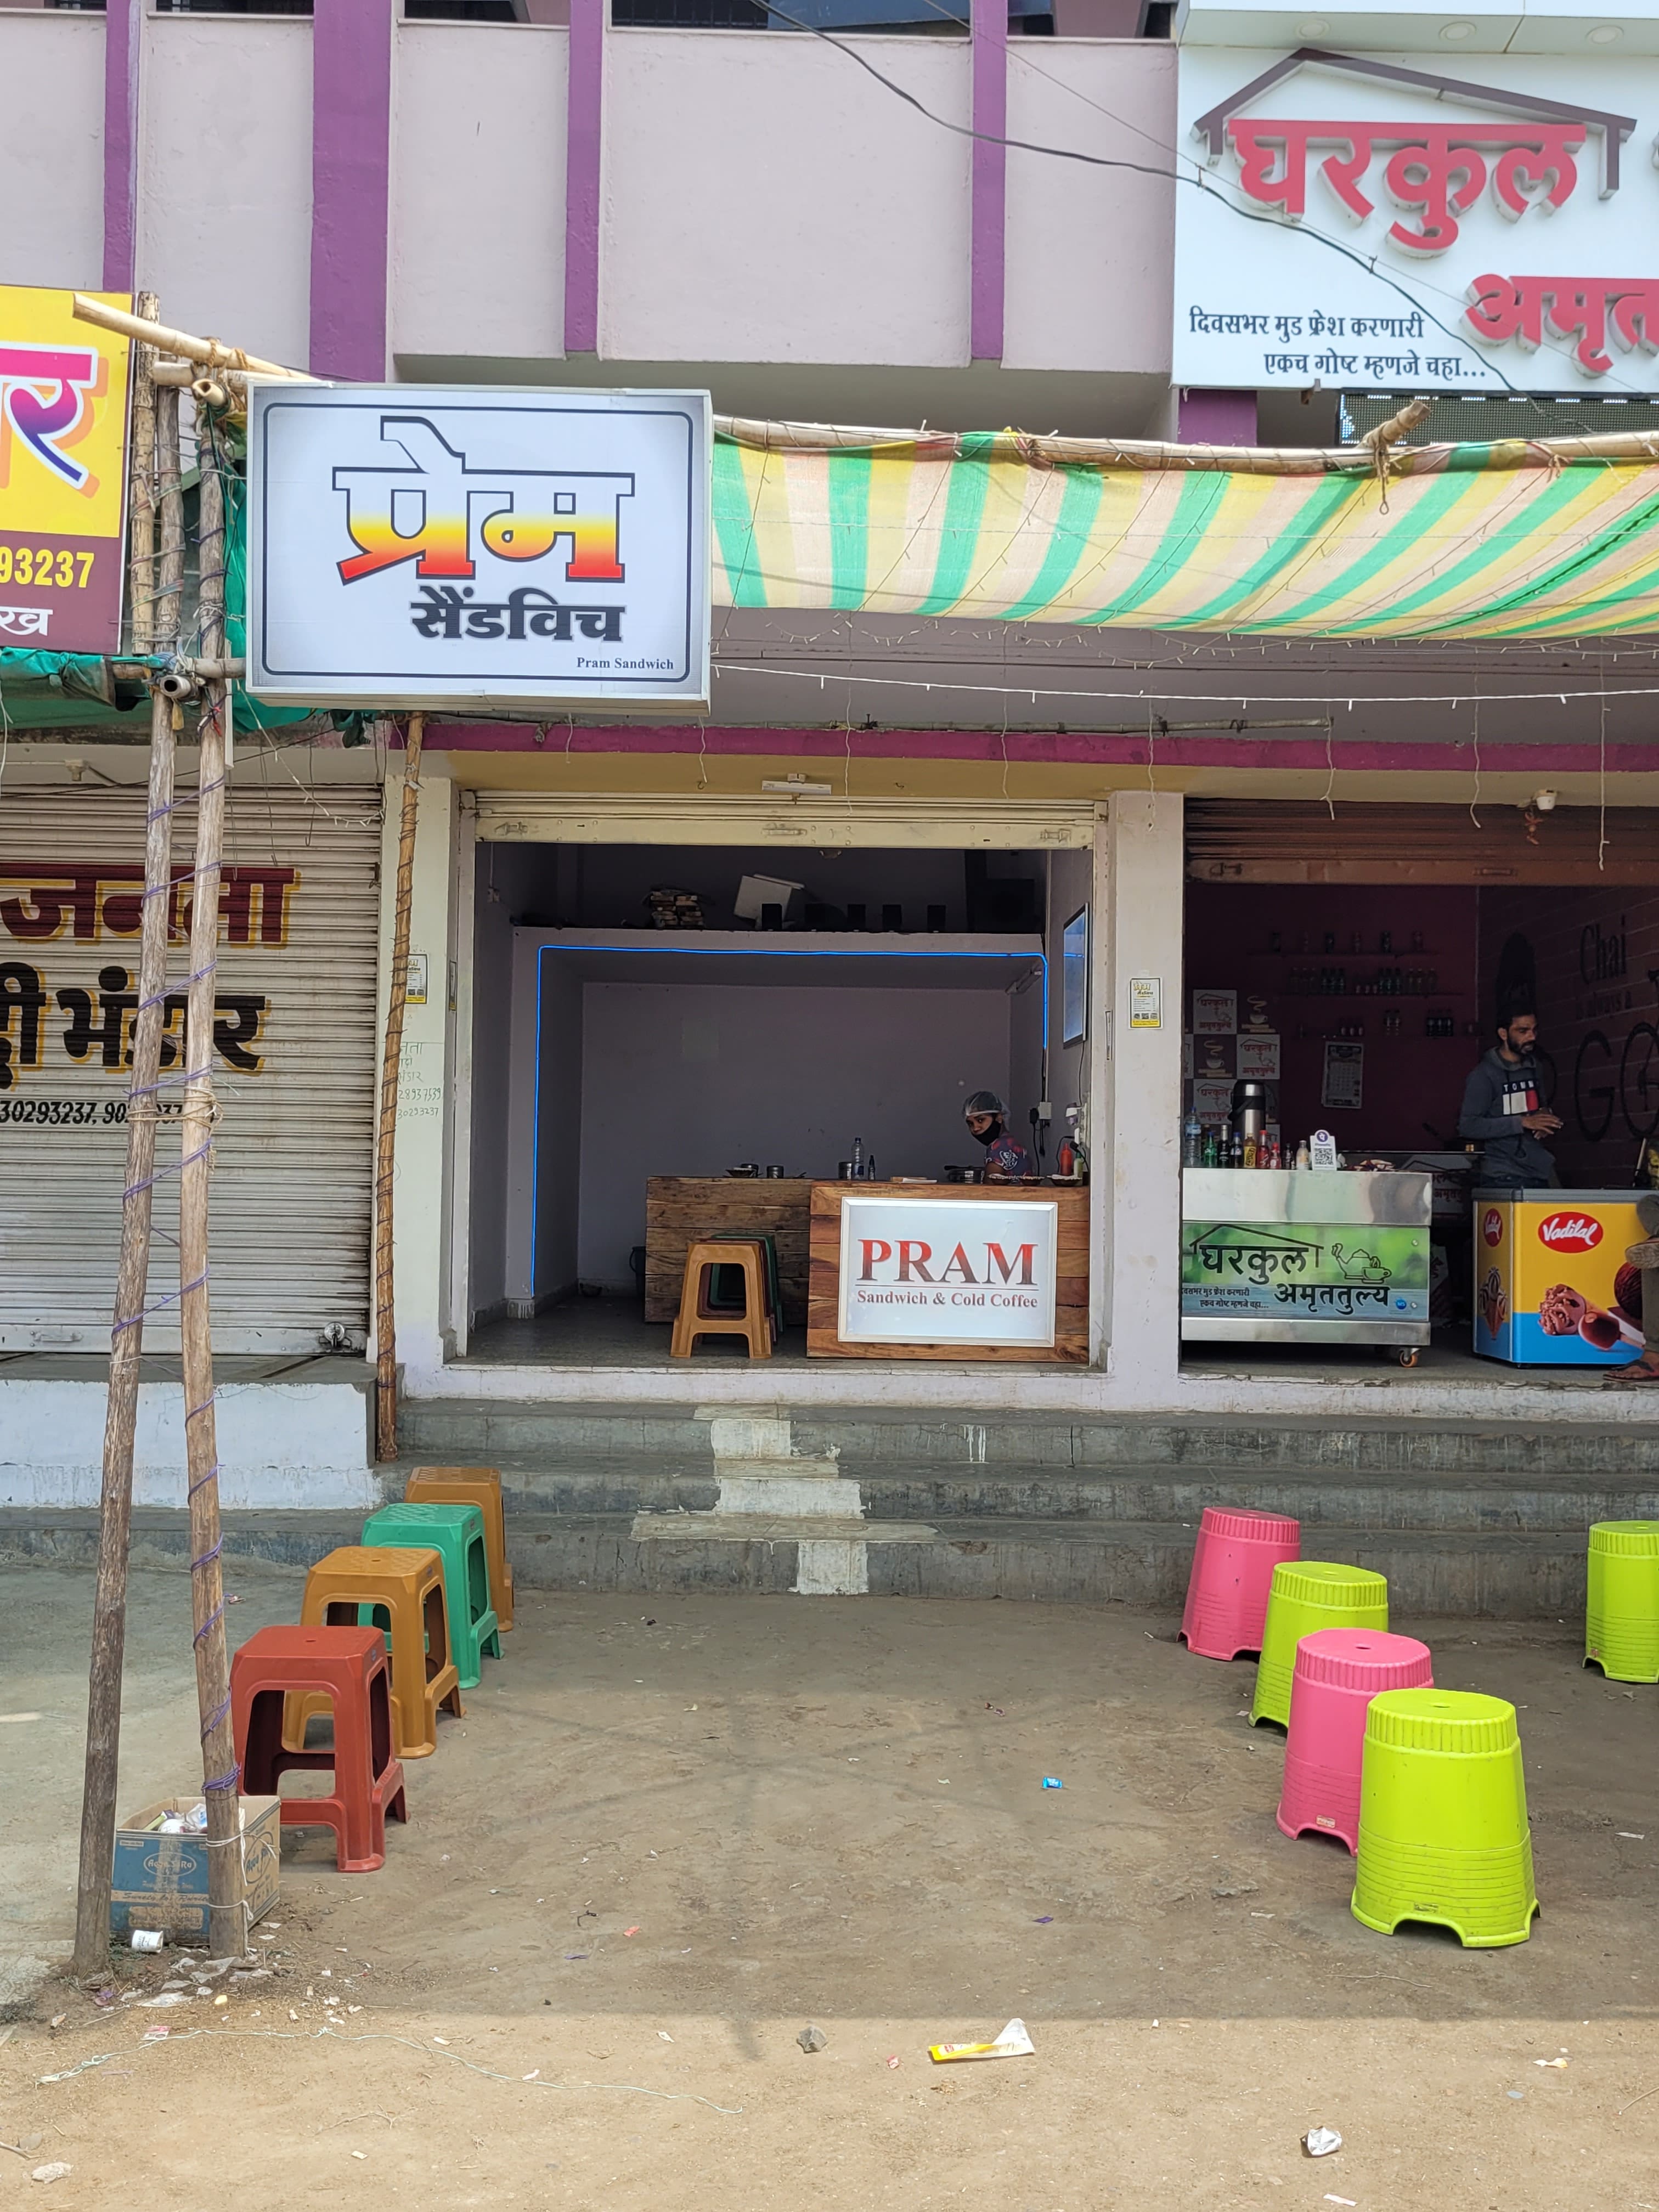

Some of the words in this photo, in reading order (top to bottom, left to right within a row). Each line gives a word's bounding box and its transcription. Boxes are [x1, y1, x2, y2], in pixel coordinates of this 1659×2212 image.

[1227, 119, 1587, 253] घरकुल
[1189, 306, 1269, 335] दिवसभर
[1275, 315, 1302, 343] मुड
[1308, 309, 1345, 336] फ्रेश
[1351, 311, 1425, 338] करणारी
[1263, 353, 1310, 374] एकच
[1314, 347, 1358, 374] गोष्ट
[1364, 349, 1420, 380] म्हणजे
[332, 415, 636, 586] प्रेम
[0, 546, 95, 588] 93237
[410, 585, 627, 642] सैंडविच
[577, 657, 610, 668] Pram
[614, 658, 674, 670] Sandwich
[1580, 915, 1627, 985] Chai
[1542, 1217, 1598, 1246] Vadilal
[856, 1239, 1039, 1285] PRAM
[1199, 1244, 1309, 1285] घरकुल
[857, 1290, 928, 1305] Sandwich
[933, 1292, 945, 1305] &
[951, 1292, 985, 1306] Cold
[990, 1293, 1038, 1308] Coffee
[1274, 1283, 1391, 1315] अमृततुल्य
